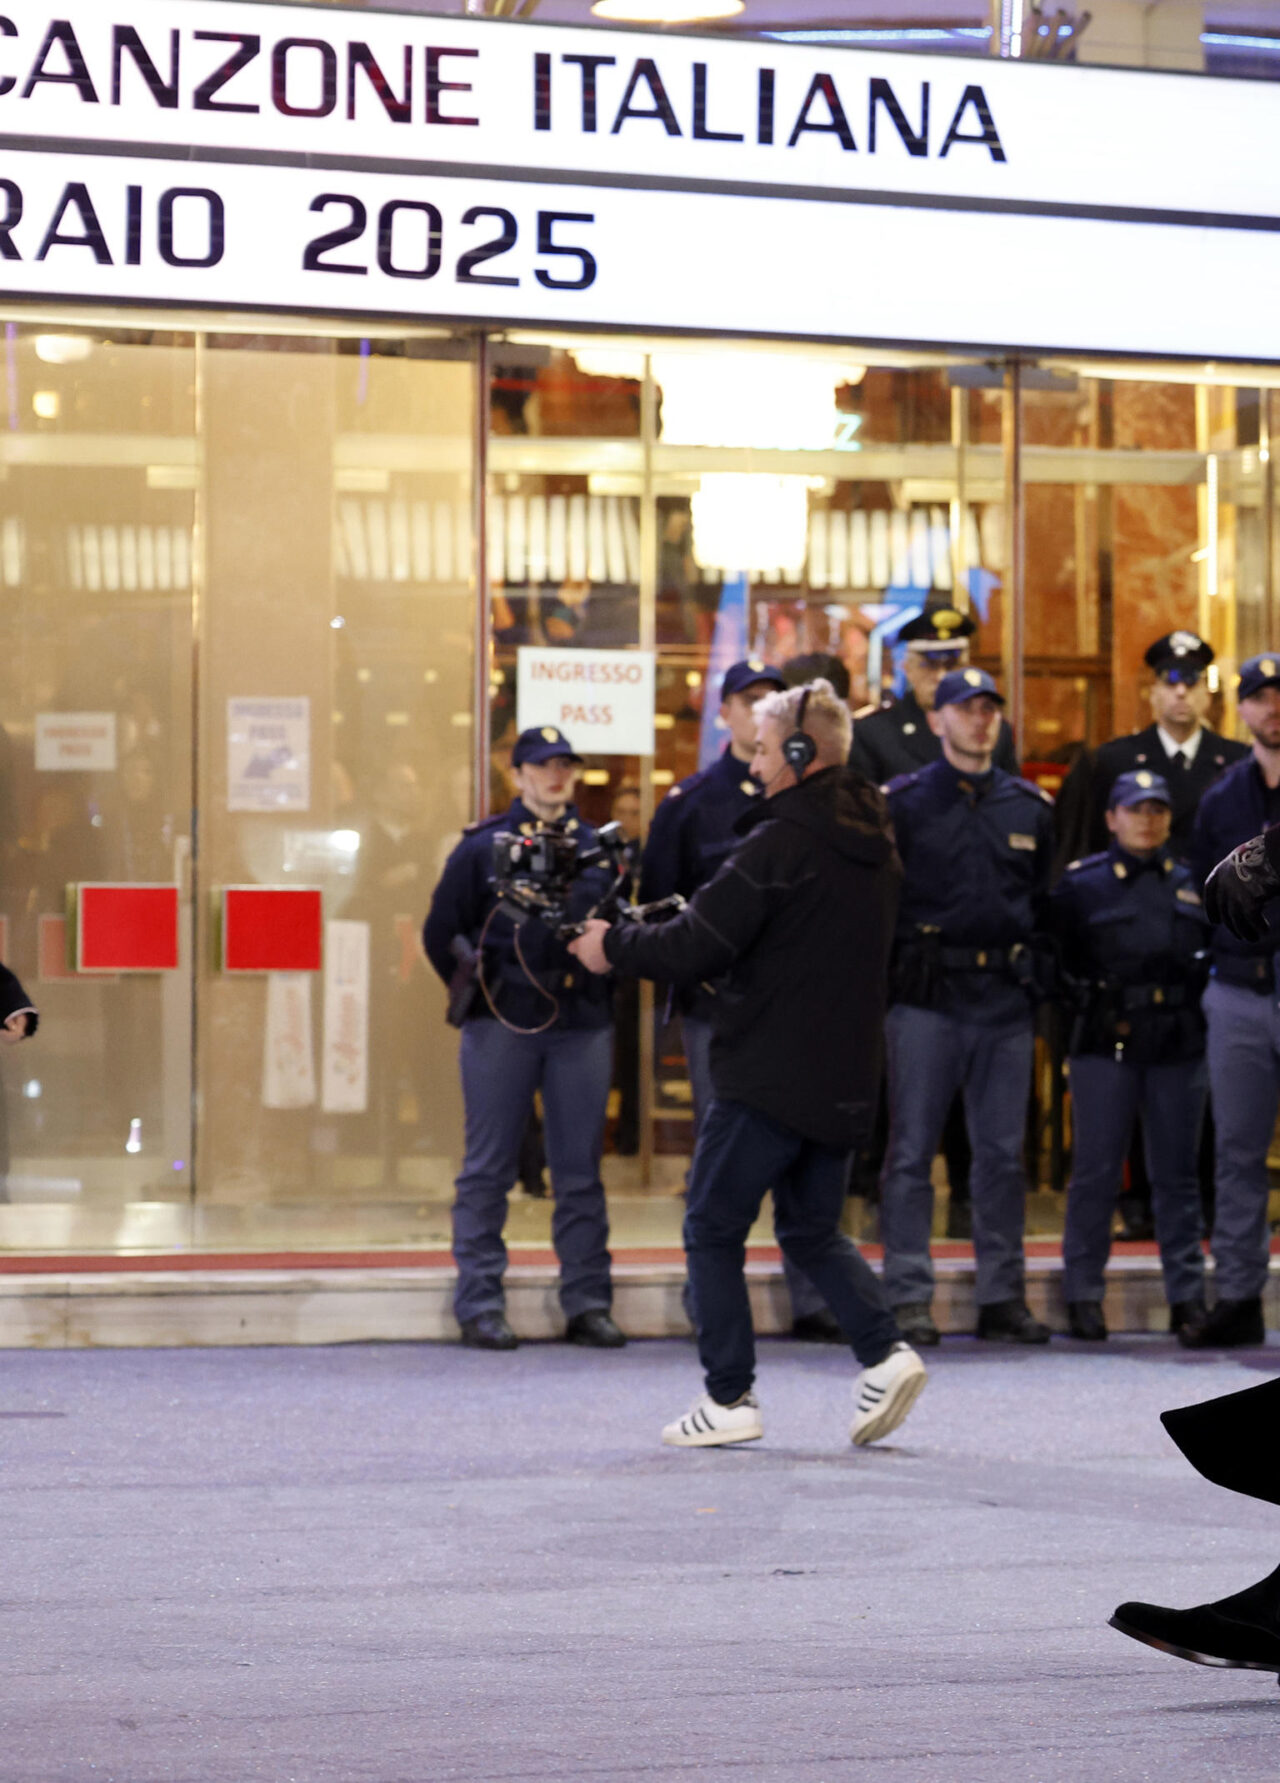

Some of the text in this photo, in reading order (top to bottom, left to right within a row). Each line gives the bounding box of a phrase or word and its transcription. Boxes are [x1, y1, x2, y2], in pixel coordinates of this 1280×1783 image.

[0, 15, 1008, 164] ANZONE ITALIANA
[302, 193, 598, 290] 2025
[530, 660, 643, 685] INGRESSO
[560, 703, 614, 725] PASS
